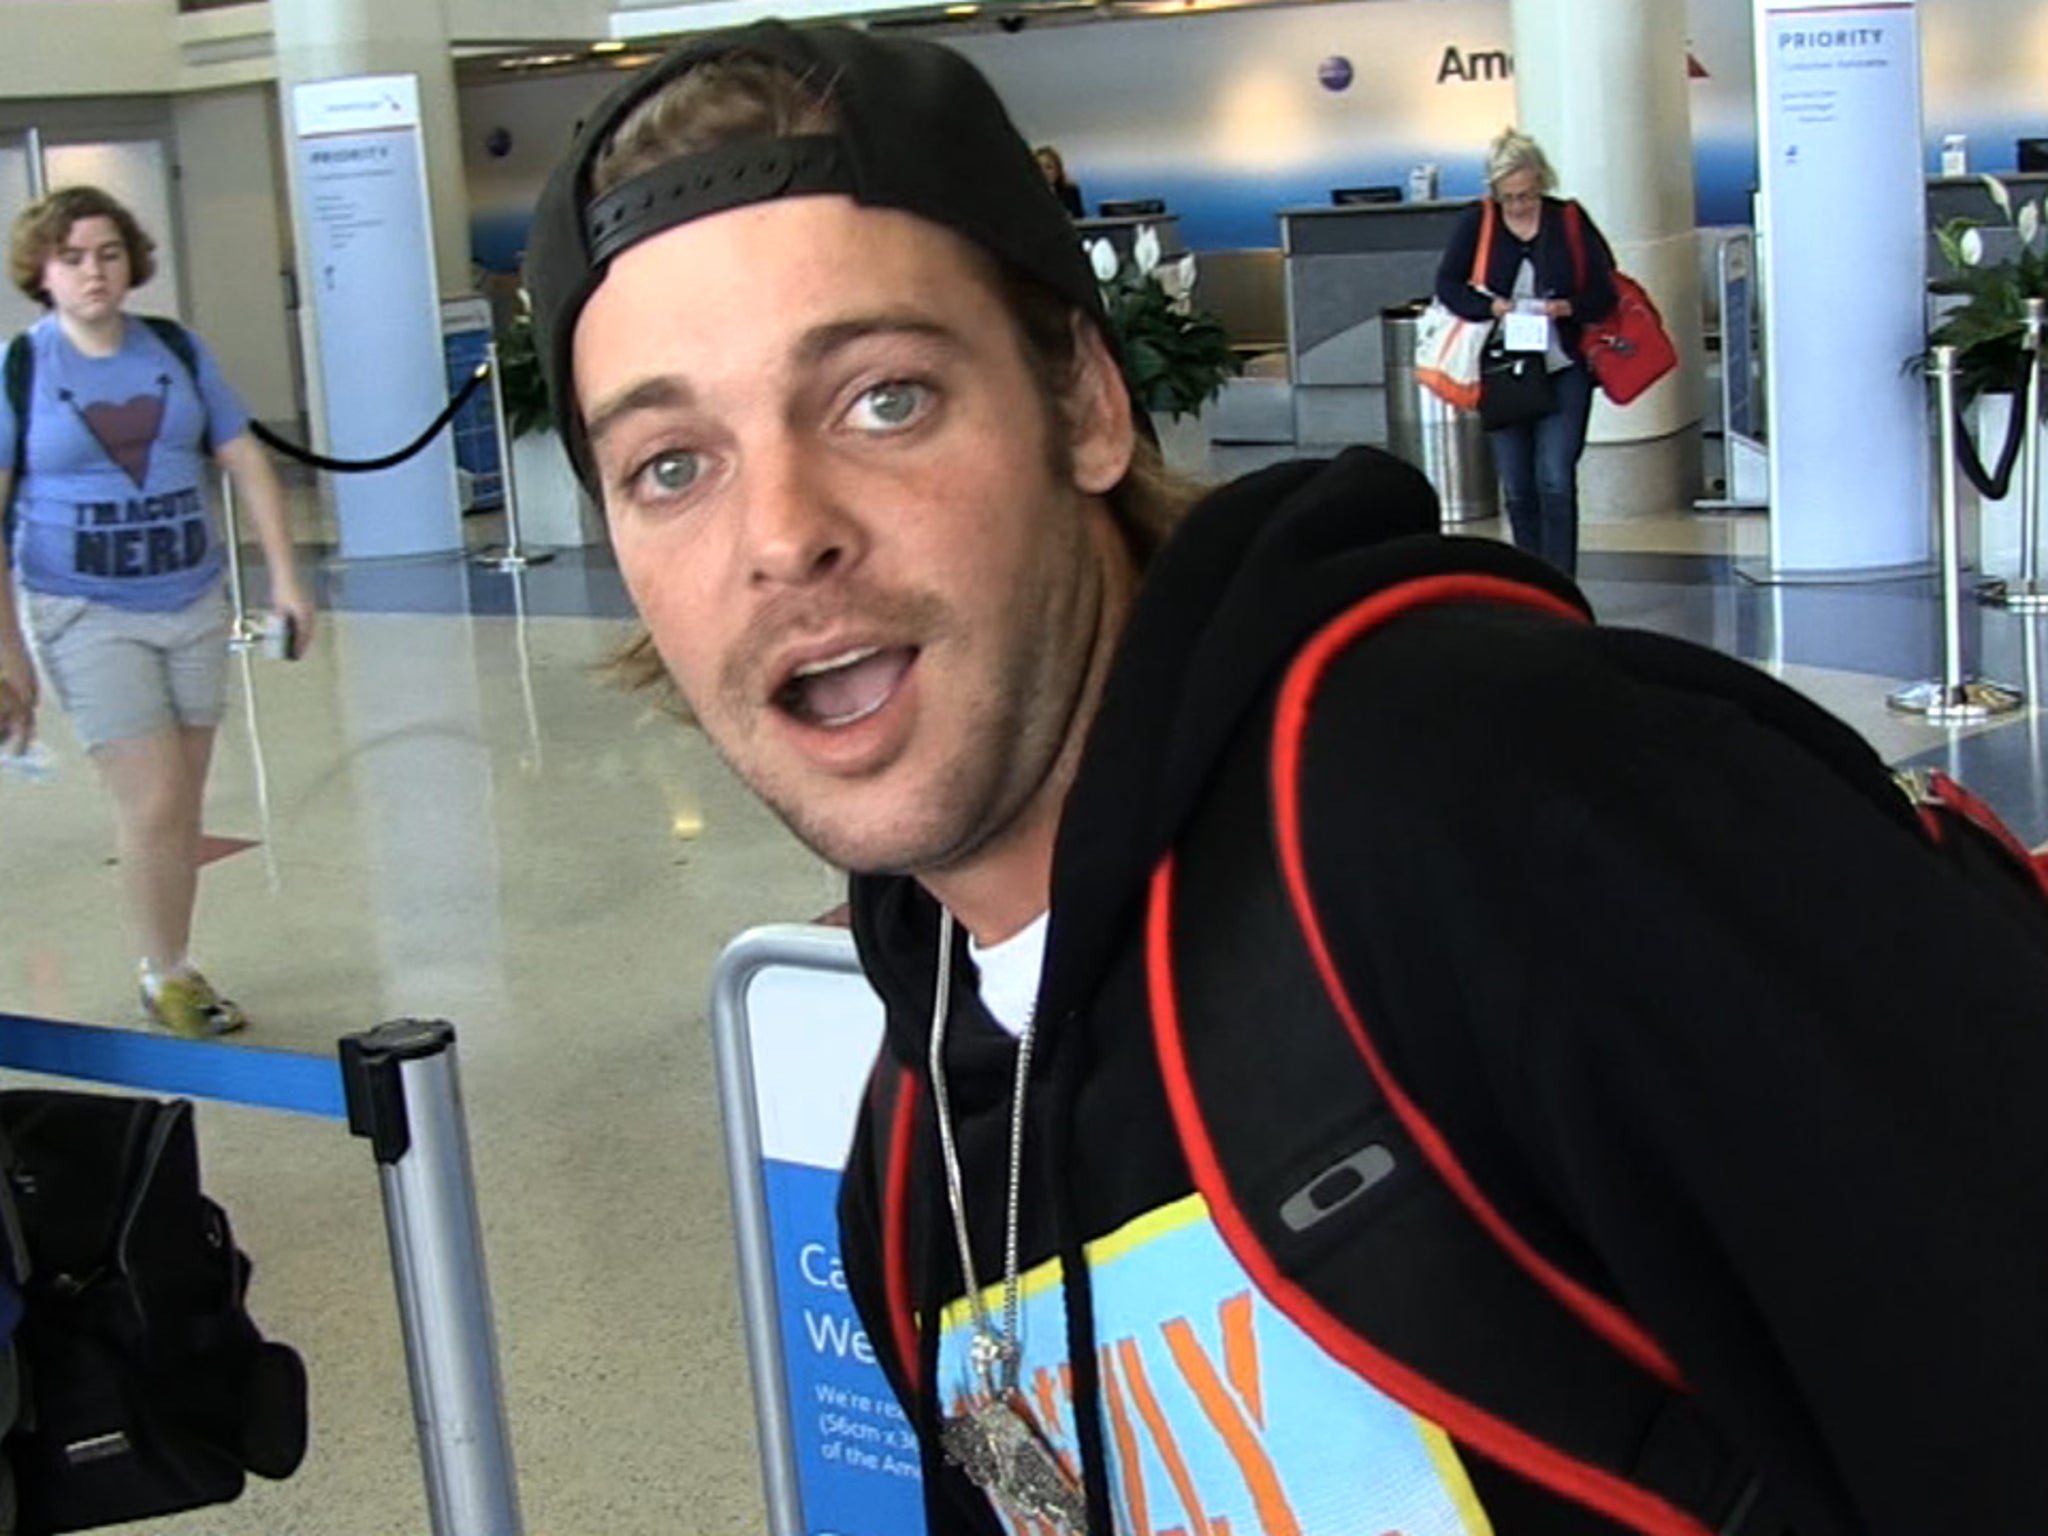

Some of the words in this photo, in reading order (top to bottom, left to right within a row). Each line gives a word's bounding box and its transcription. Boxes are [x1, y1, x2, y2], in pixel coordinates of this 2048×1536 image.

[1778, 29, 1884, 49] PRIORITY
[310, 146, 390, 164] PRIORITY
[75, 518, 206, 578] NERD
[800, 1242, 847, 1290] Ca
[815, 1384, 872, 1413] We're
[821, 1442, 844, 1460] of
[846, 1446, 879, 1469] the
